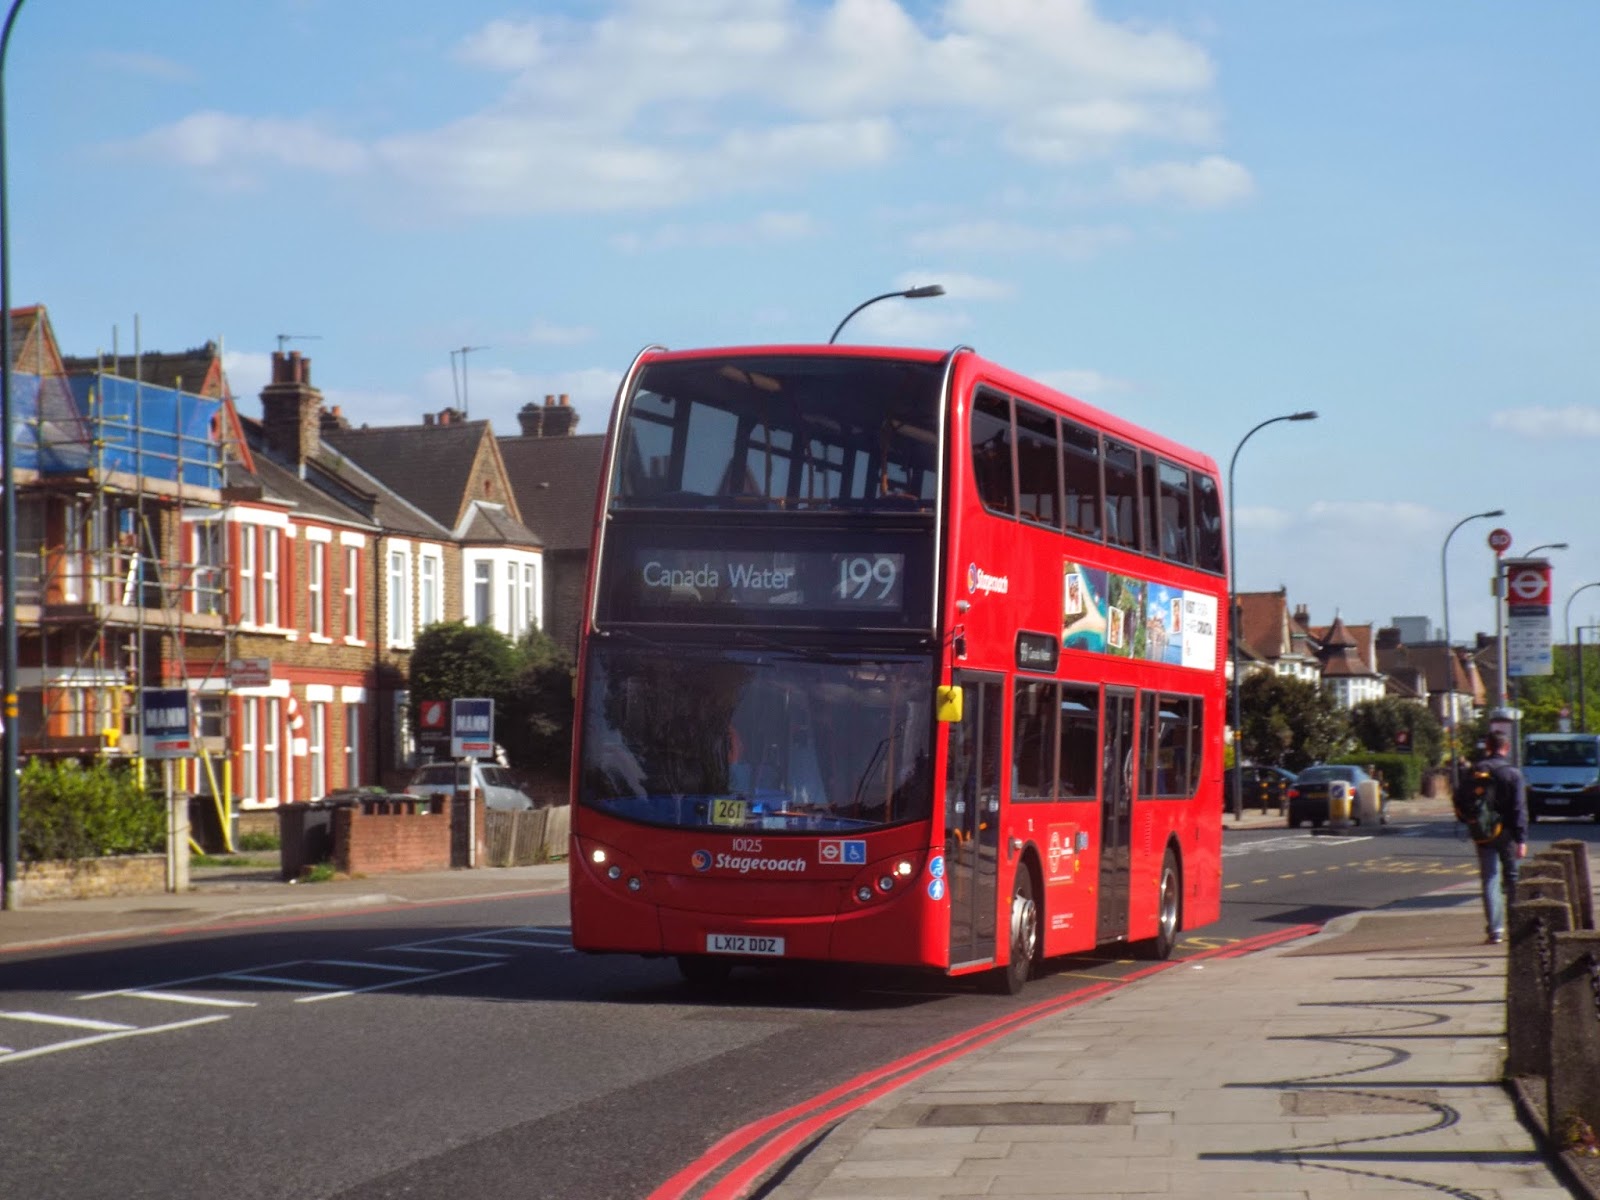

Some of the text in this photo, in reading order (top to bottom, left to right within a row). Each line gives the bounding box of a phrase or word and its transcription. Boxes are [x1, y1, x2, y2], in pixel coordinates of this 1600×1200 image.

[643, 562, 794, 589] Canada Water
[840, 558, 897, 600] 199
[719, 801, 742, 819] 261
[732, 838, 763, 853] 10125
[715, 853, 807, 874] Stagecoach
[714, 936, 776, 953] LX12 DDZ
